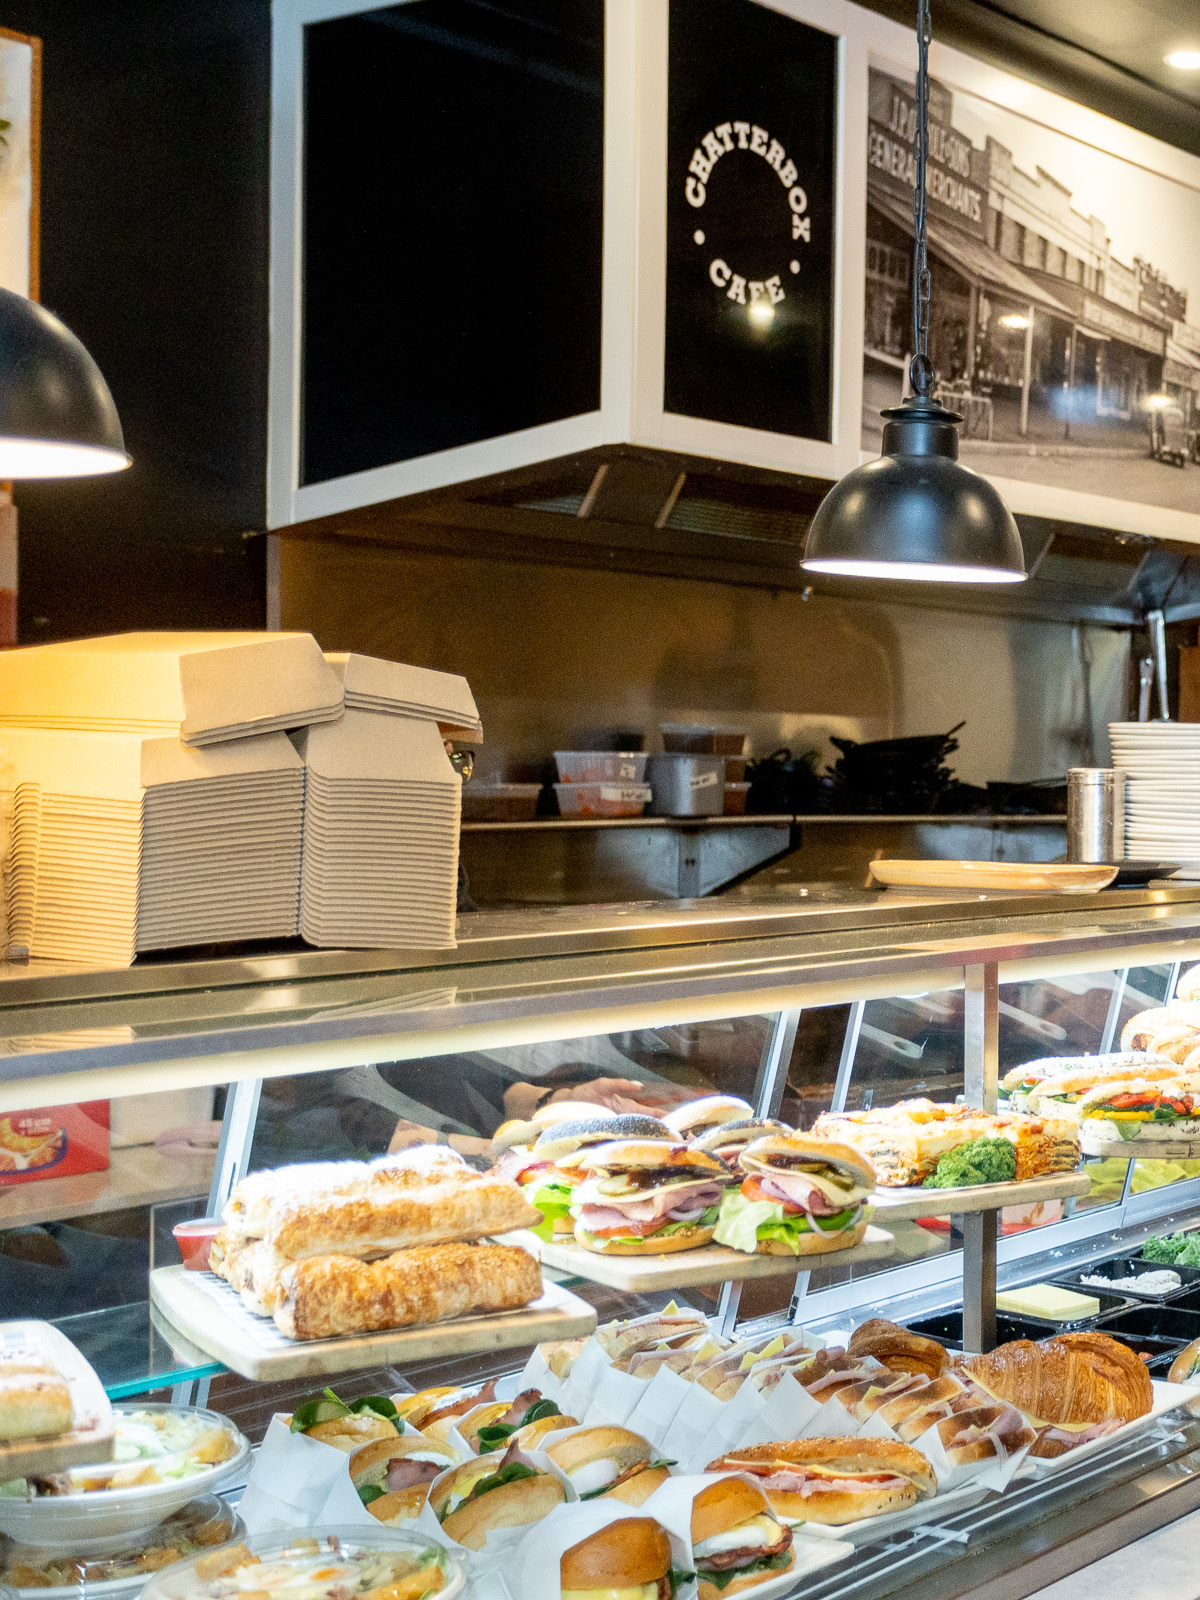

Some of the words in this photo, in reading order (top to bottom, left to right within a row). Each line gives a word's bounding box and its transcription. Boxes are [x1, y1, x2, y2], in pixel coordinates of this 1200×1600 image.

[685, 120, 811, 243] CHATTERBOX
[868, 128, 920, 188] GENERA
[709, 258, 785, 306] CAFE
